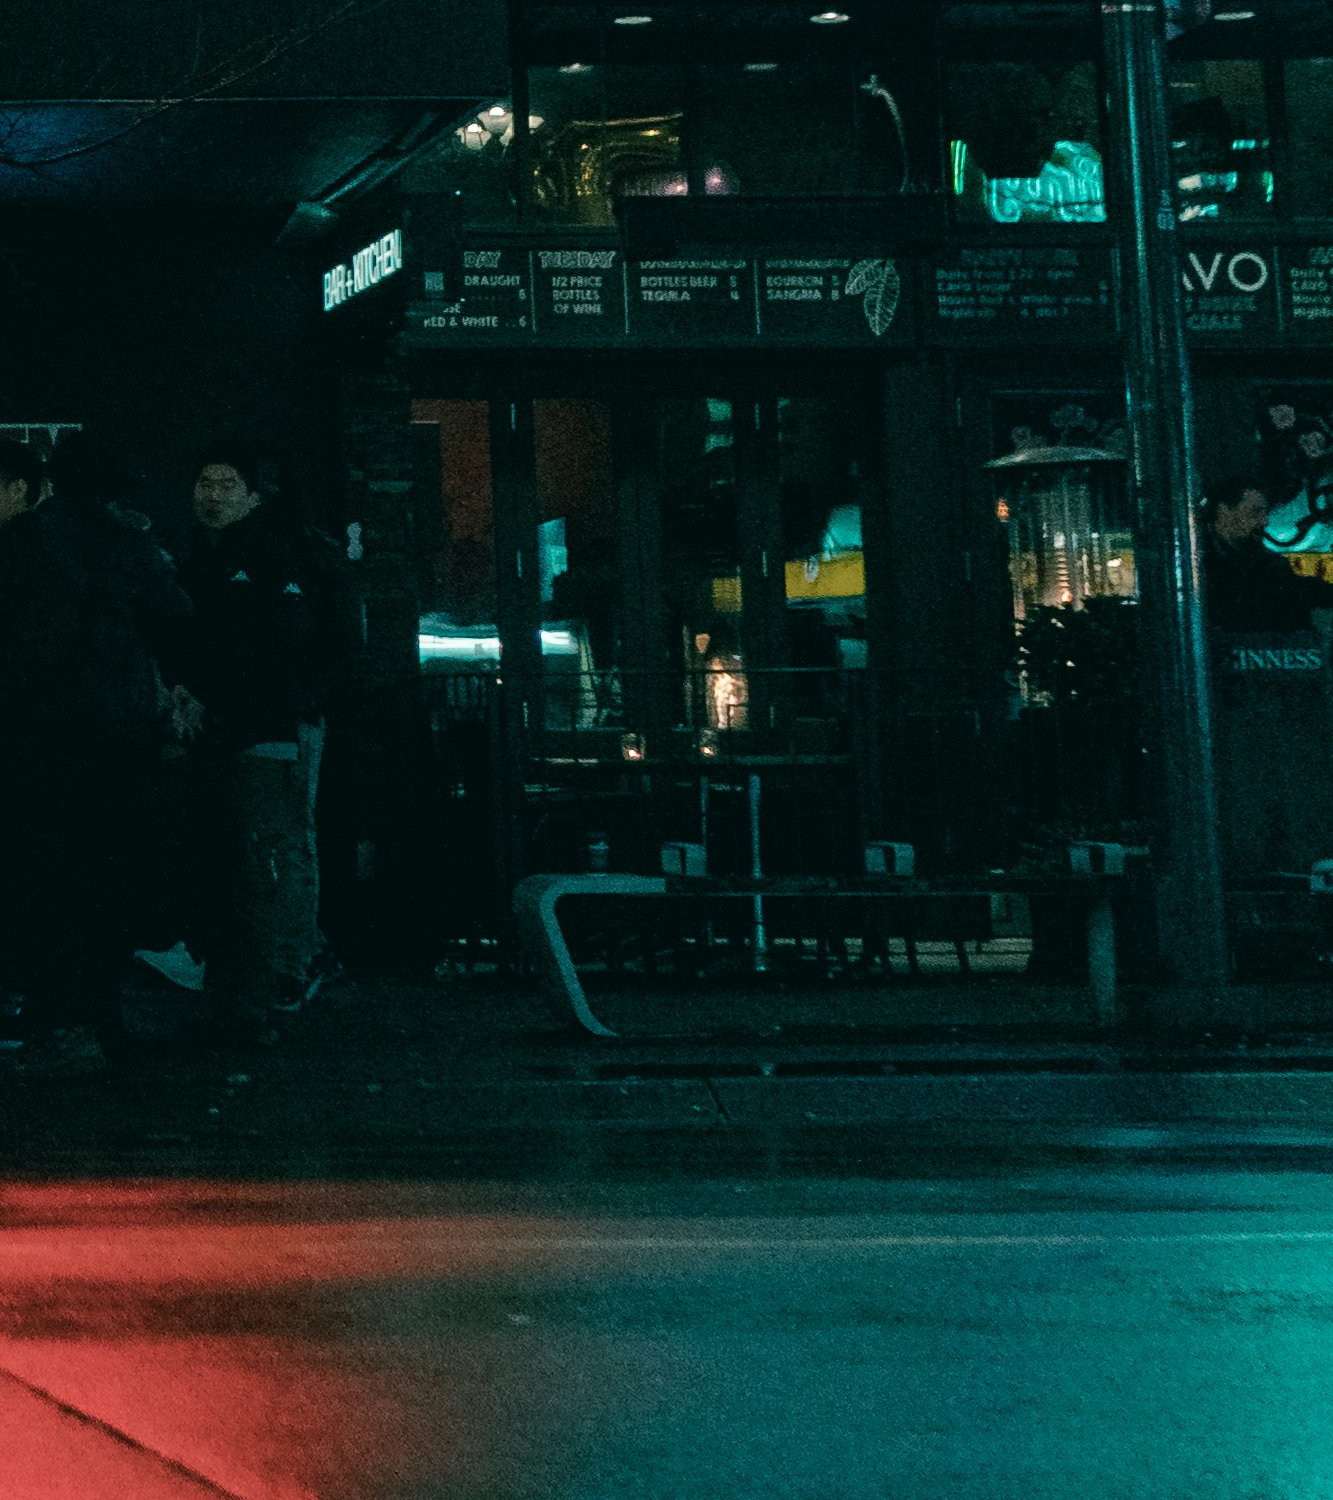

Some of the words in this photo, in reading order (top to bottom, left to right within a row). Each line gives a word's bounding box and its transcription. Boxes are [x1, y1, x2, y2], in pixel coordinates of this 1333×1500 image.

[1181, 251, 1269, 292] VO
[463, 274, 522, 287] DRAUGHT
[570, 275, 604, 287] PRICE
[765, 288, 823, 301] SANGRIA
[461, 315, 499, 328] WHITE
[1231, 647, 1323, 671] INNESS
